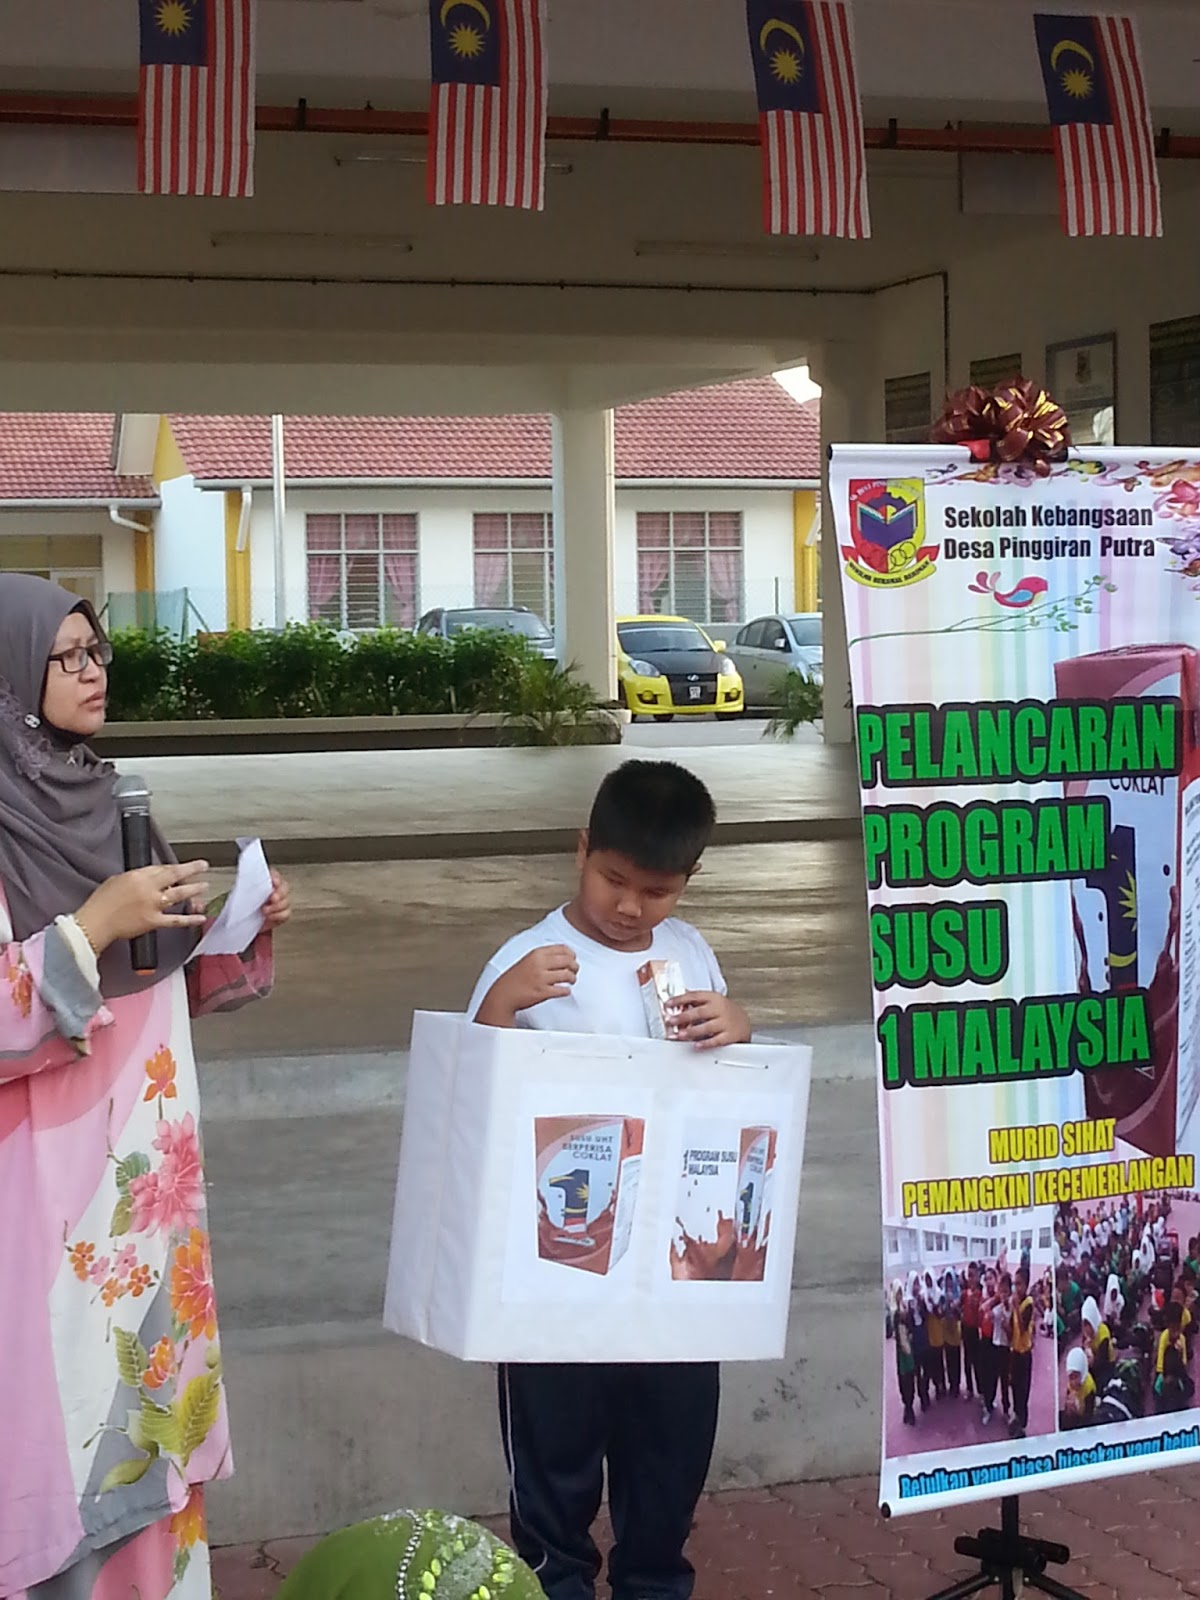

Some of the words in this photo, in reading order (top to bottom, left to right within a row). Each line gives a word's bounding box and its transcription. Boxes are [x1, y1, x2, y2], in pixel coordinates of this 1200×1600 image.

[944, 505, 1027, 528] Sekolah
[1031, 504, 1154, 529] Kebangsaan
[943, 537, 995, 560] Desa
[1000, 536, 1092, 561] Pinggiran
[1100, 535, 1156, 558] Putra
[858, 702, 1177, 784] PELANCARAN
[864, 802, 1107, 883] PROGRAM
[871, 906, 1003, 985] SUSU
[878, 1011, 900, 1083] 1
[911, 994, 1152, 1080] MALAYSIA
[595, 1135, 613, 1143] UHT
[988, 1124, 1060, 1164] MURID
[1062, 1118, 1116, 1157] SIHAT
[572, 1151, 613, 1161] COKLAT
[688, 1163, 719, 1175] MALAYSIA
[689, 1150, 720, 1162] PROGRAM
[903, 1172, 1030, 1217] PEMANGKIN
[1033, 1154, 1195, 1206] KECEMERLANGAN
[900, 1467, 969, 1499] Betulkan
